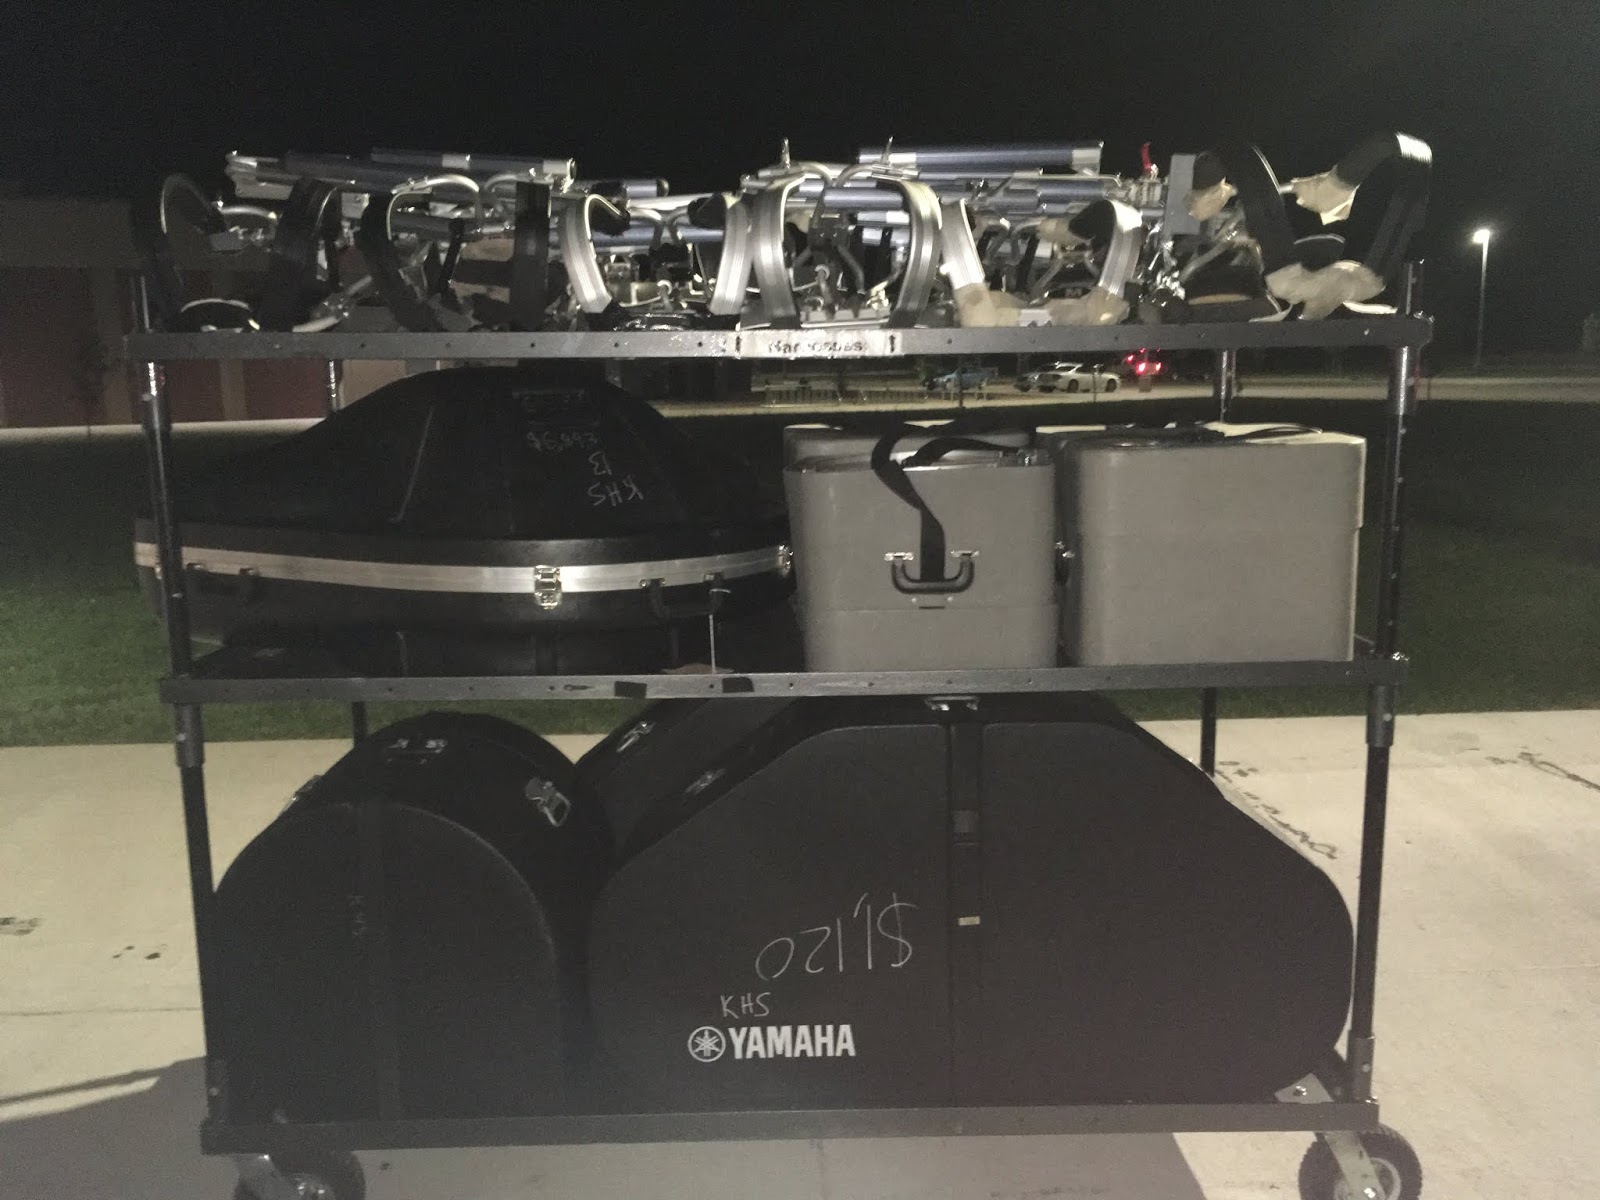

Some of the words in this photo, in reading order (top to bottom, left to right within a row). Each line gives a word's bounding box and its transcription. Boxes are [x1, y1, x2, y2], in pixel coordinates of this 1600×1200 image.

[587, 475, 644, 506] KHS
[755, 892, 918, 982] $1,120
[720, 992, 772, 1019] KHS
[728, 1024, 856, 1059] YAMAHA
